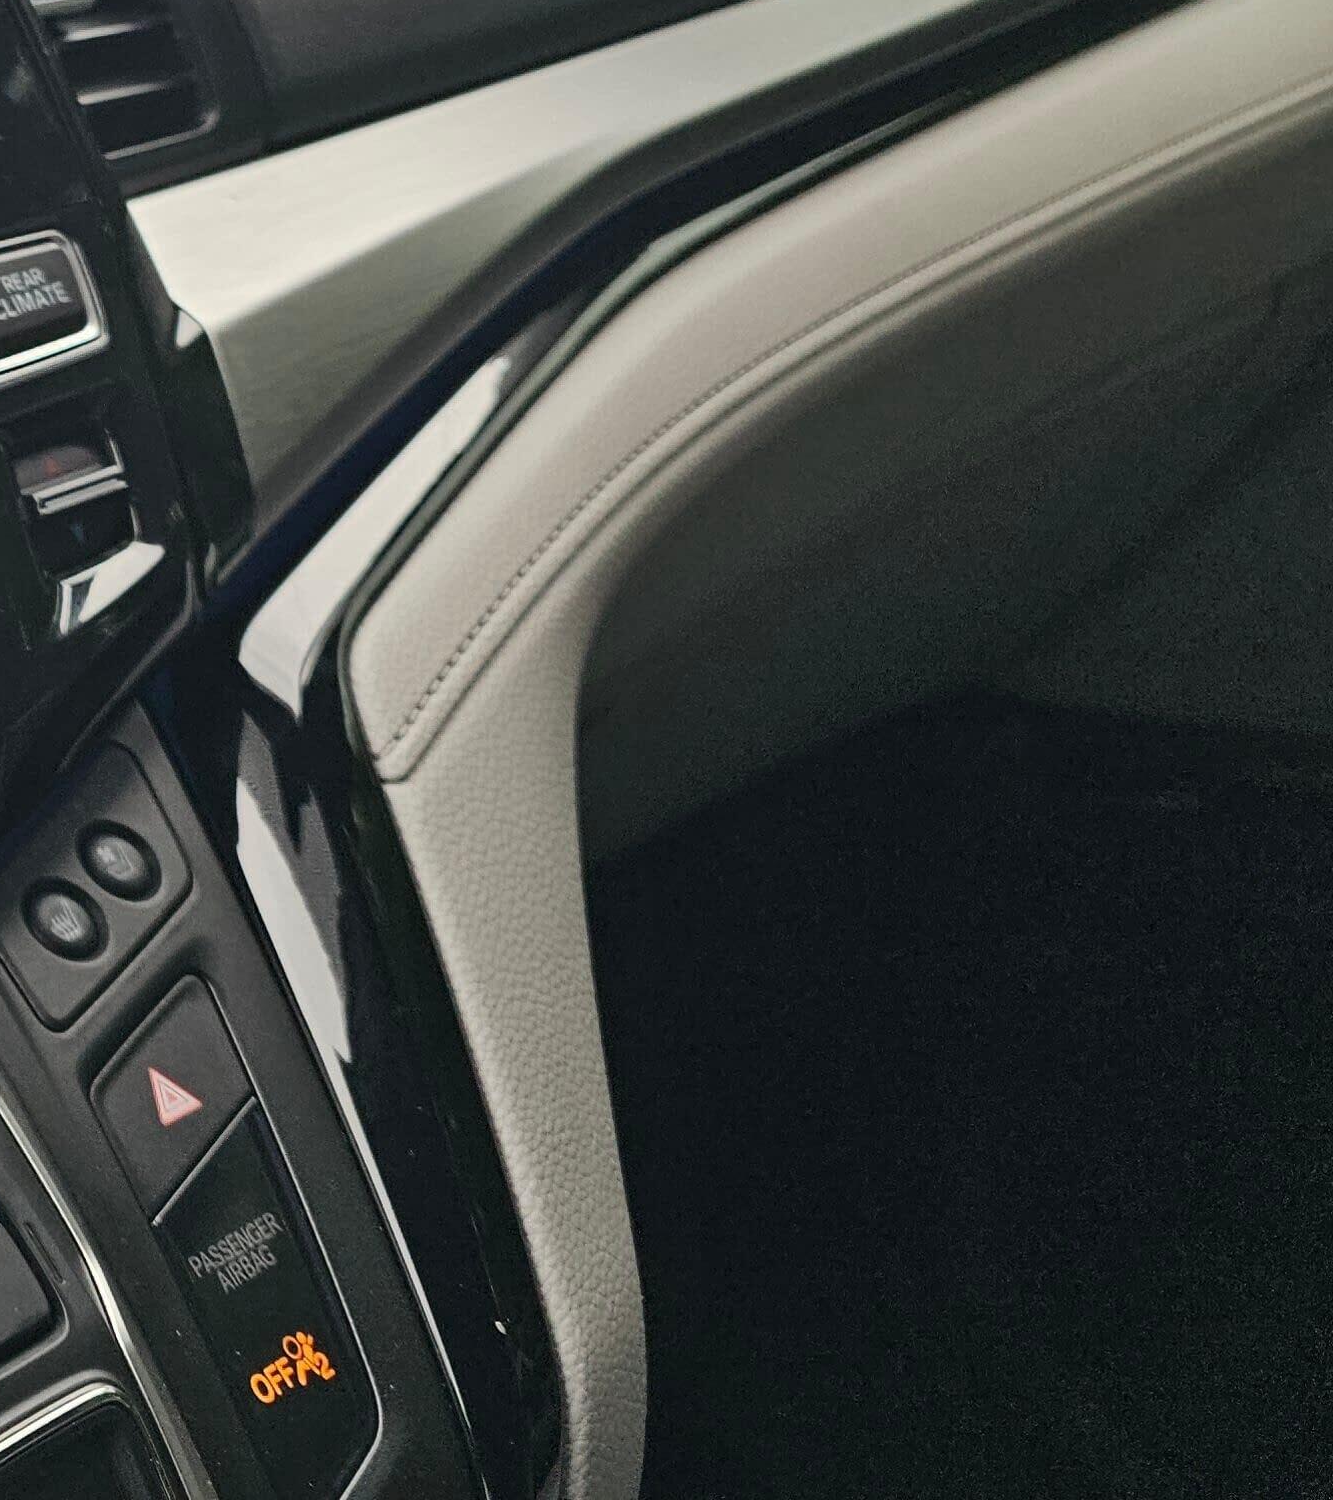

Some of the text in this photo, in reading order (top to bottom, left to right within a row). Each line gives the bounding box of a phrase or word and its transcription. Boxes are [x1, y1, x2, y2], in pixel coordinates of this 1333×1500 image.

[0, 266, 46, 294] REAR
[187, 1210, 283, 1280] PASSENGER
[216, 1243, 278, 1295] AIRBAG
[249, 1353, 299, 1405] OFF
